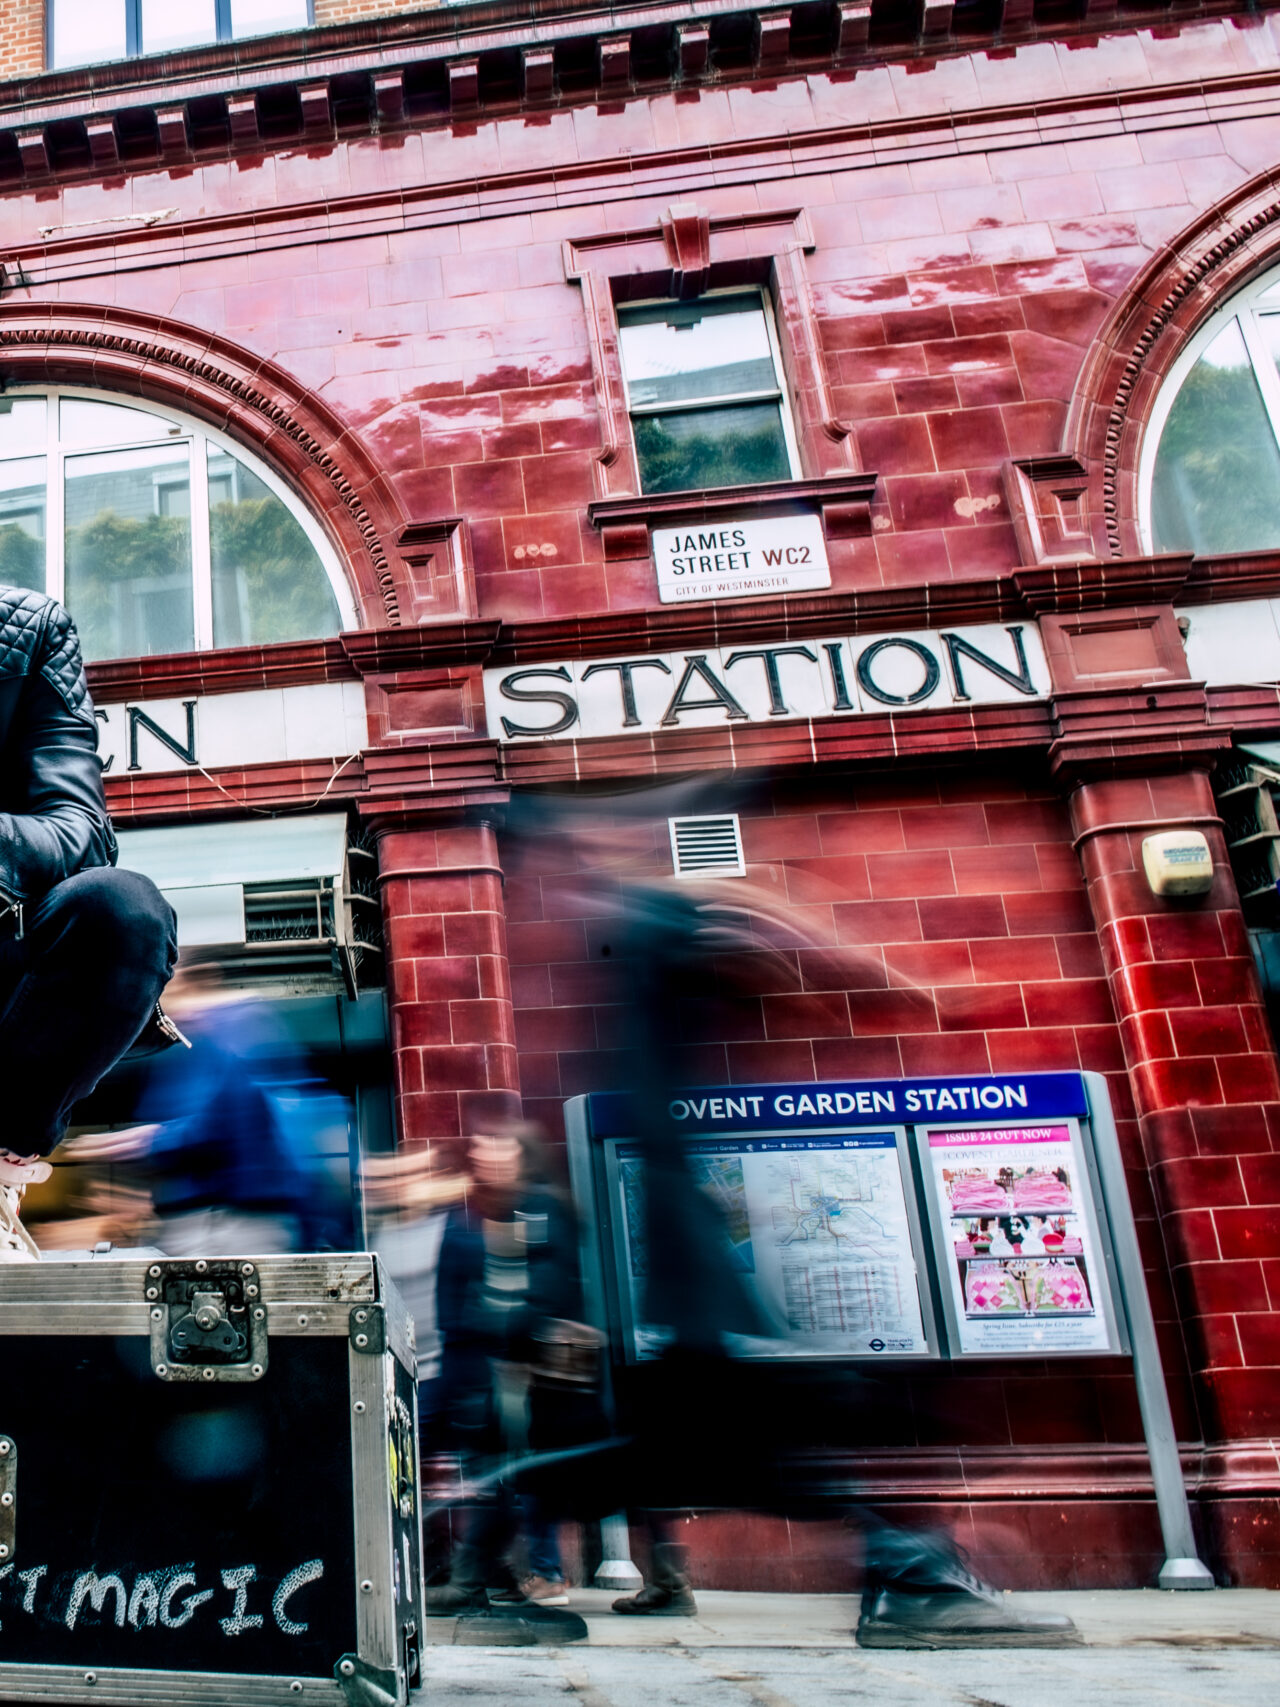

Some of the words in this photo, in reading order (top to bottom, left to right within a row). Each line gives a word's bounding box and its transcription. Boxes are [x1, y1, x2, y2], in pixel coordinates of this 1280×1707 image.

[670, 530, 746, 553] JAMES
[672, 551, 751, 575] STREET
[762, 546, 812, 566] WC2
[676, 586, 697, 596] CITY
[702, 584, 713, 594] OF
[717, 577, 789, 592] WESTMINSTER
[499, 626, 1039, 739] STATION
[669, 1096, 764, 1120] OVENT
[774, 1090, 896, 1117] GARDEN
[904, 1085, 1028, 1112] STATION
[945, 1131, 978, 1143] ISSUE
[980, 1132, 992, 1142] 24
[994, 1130, 1018, 1141] OUT
[1023, 1128, 1052, 1139] NOW
[65, 1558, 324, 1636] MAGIC
